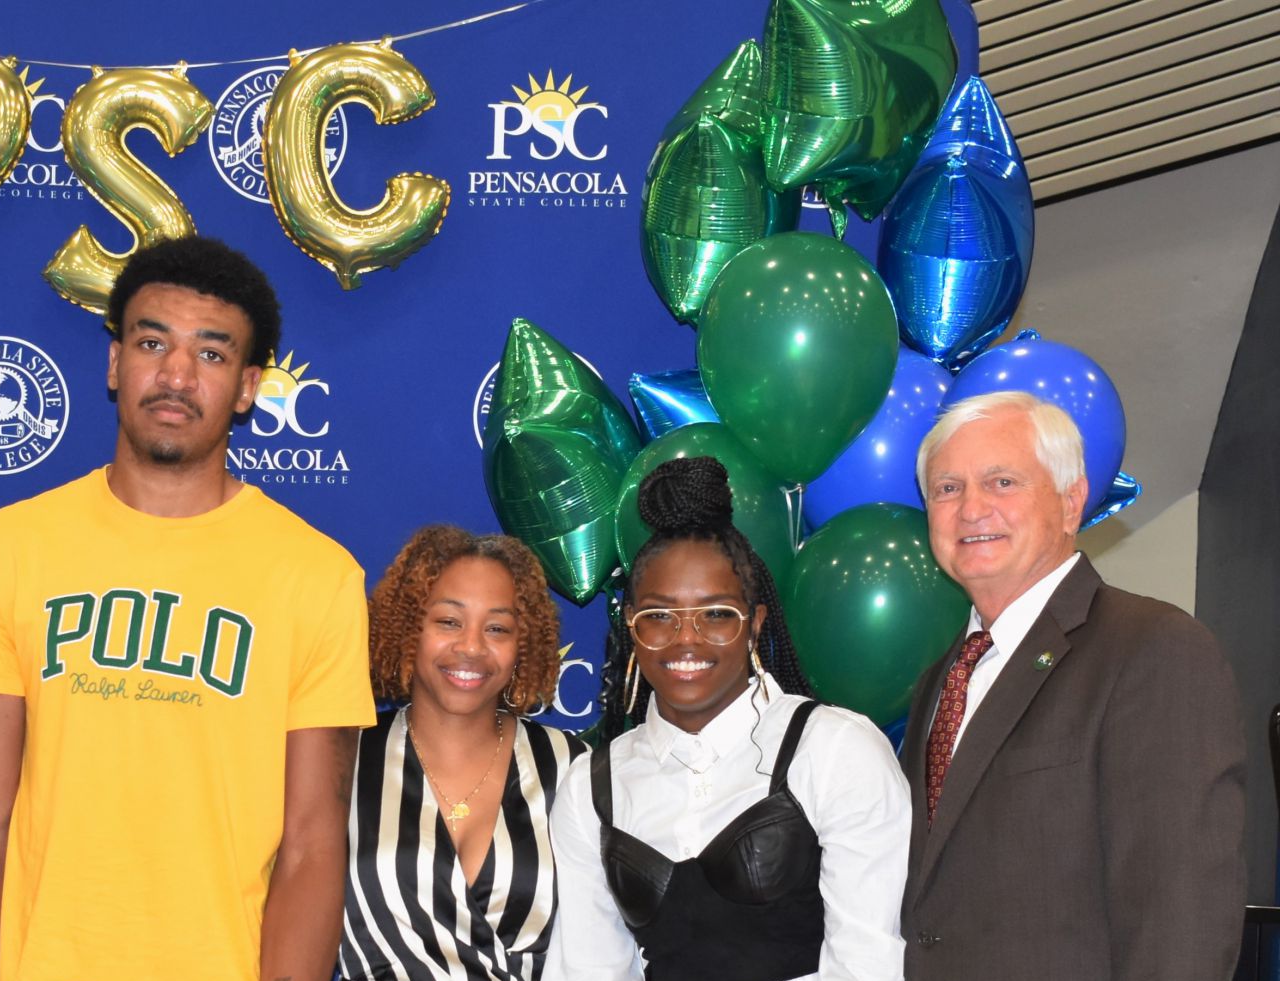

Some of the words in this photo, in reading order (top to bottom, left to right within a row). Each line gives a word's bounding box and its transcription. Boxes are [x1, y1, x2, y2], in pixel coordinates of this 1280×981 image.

[486, 103, 609, 161] PSC
[468, 172, 628, 195] PENSACOLA
[468, 198, 525, 207] STATE
[540, 198, 627, 208] COLLEGE
[26, 355, 62, 408] STATE
[251, 380, 330, 437] SC
[225, 448, 350, 472] NSACOLA
[262, 475, 349, 485] COLLEGE
[41, 588, 254, 699] POLO
[69, 672, 129, 701] Ralph
[134, 679, 203, 707] Lauren
